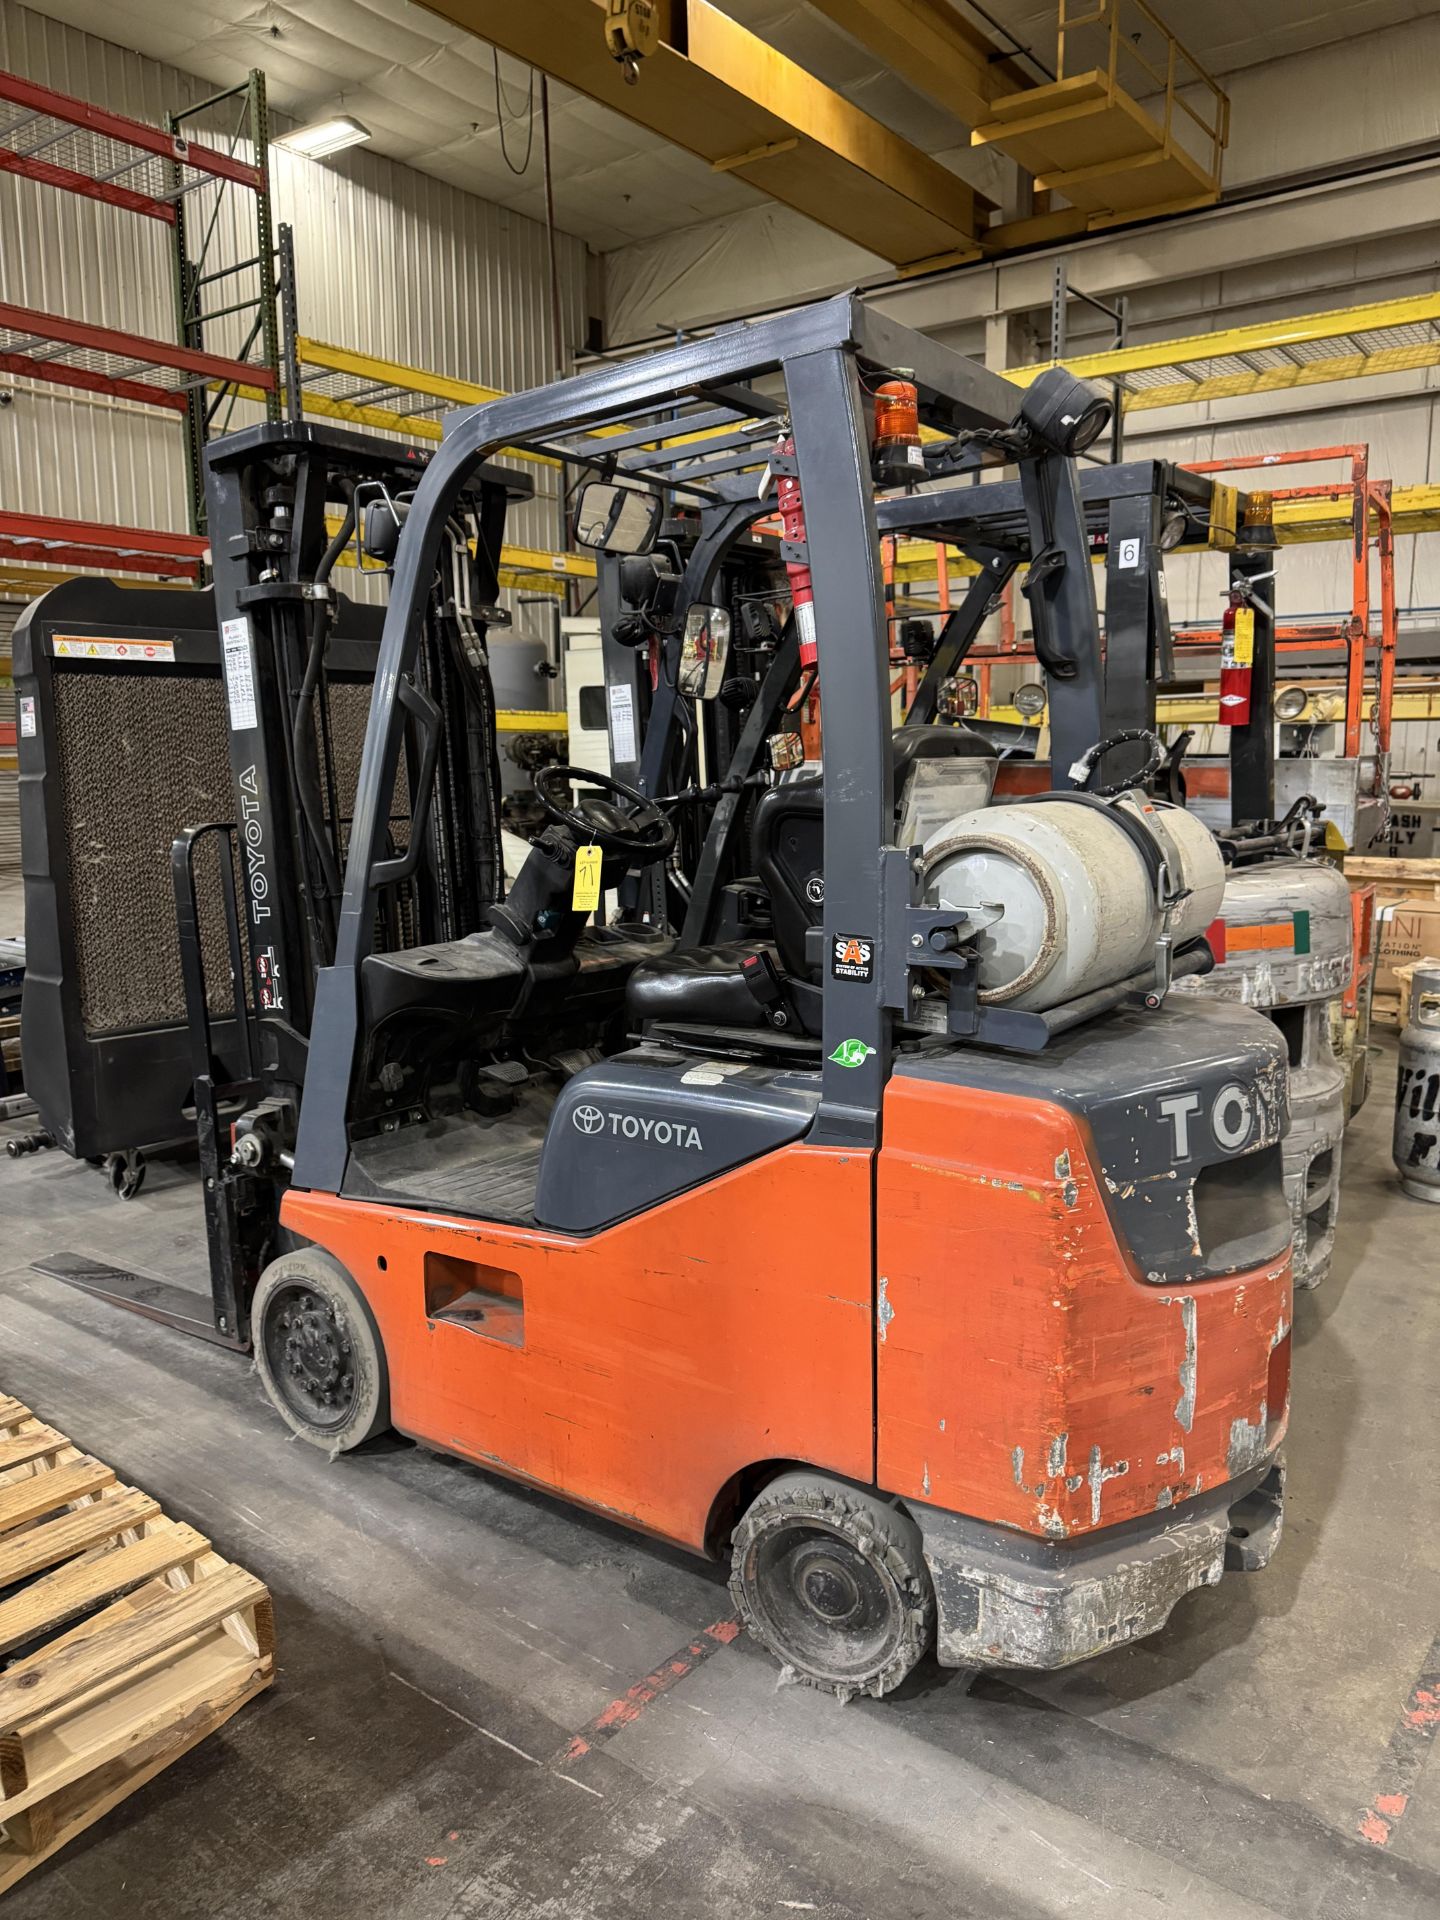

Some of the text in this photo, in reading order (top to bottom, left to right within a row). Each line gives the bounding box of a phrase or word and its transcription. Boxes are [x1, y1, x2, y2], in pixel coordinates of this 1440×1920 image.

[1124, 544, 1135, 562] 6
[239, 764, 272, 925] TOYOTA
[835, 938, 871, 965] SAS
[835, 968, 869, 978] STABILITY
[608, 1112, 703, 1151] TOYOTA
